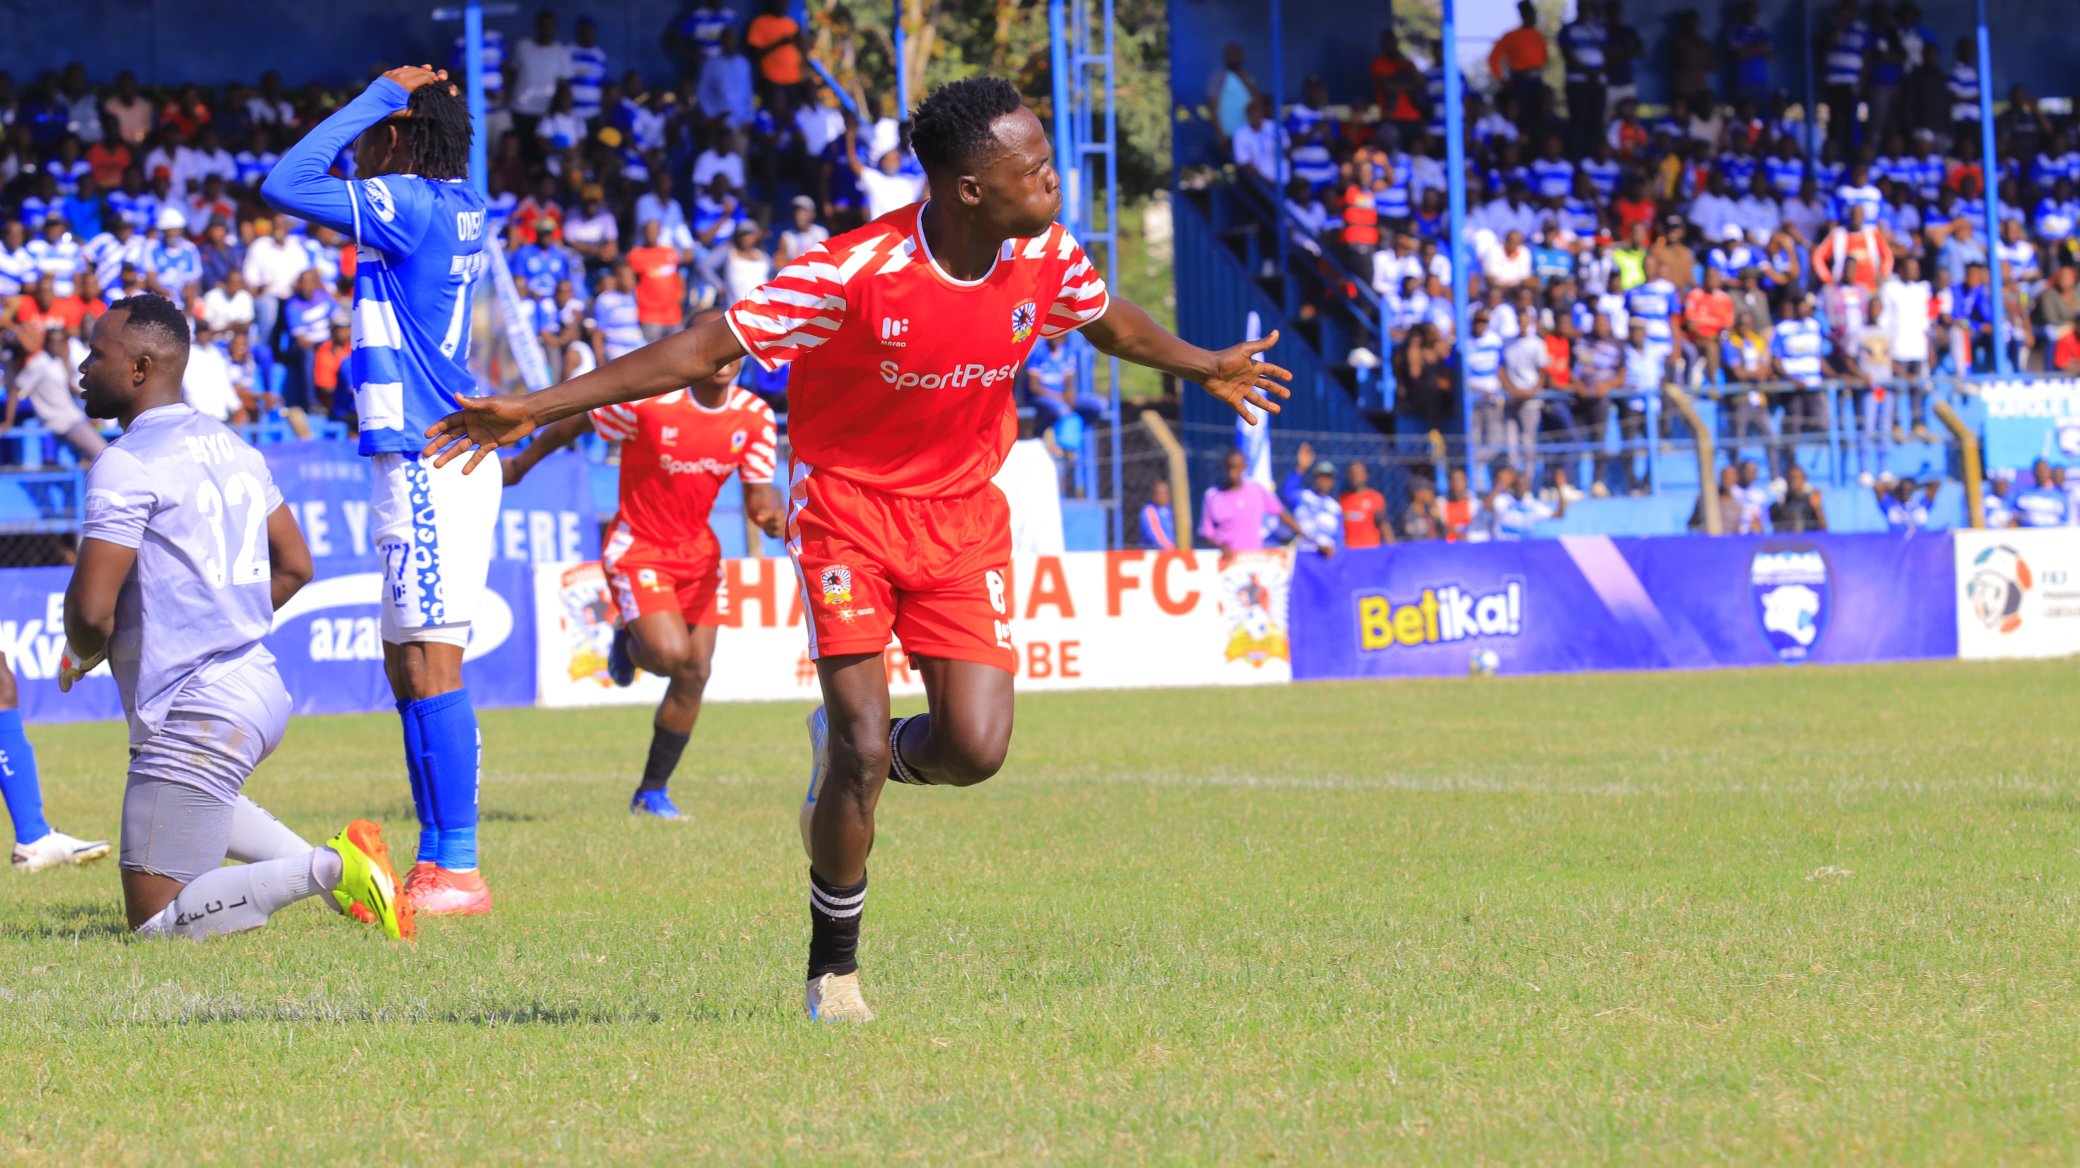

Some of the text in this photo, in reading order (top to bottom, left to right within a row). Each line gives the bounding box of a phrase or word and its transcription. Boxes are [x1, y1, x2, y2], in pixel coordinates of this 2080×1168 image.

[196, 471, 272, 590] 32
[1105, 549, 1201, 618] FC
[1359, 582, 1521, 651] Betika!
[309, 616, 385, 662] aza
